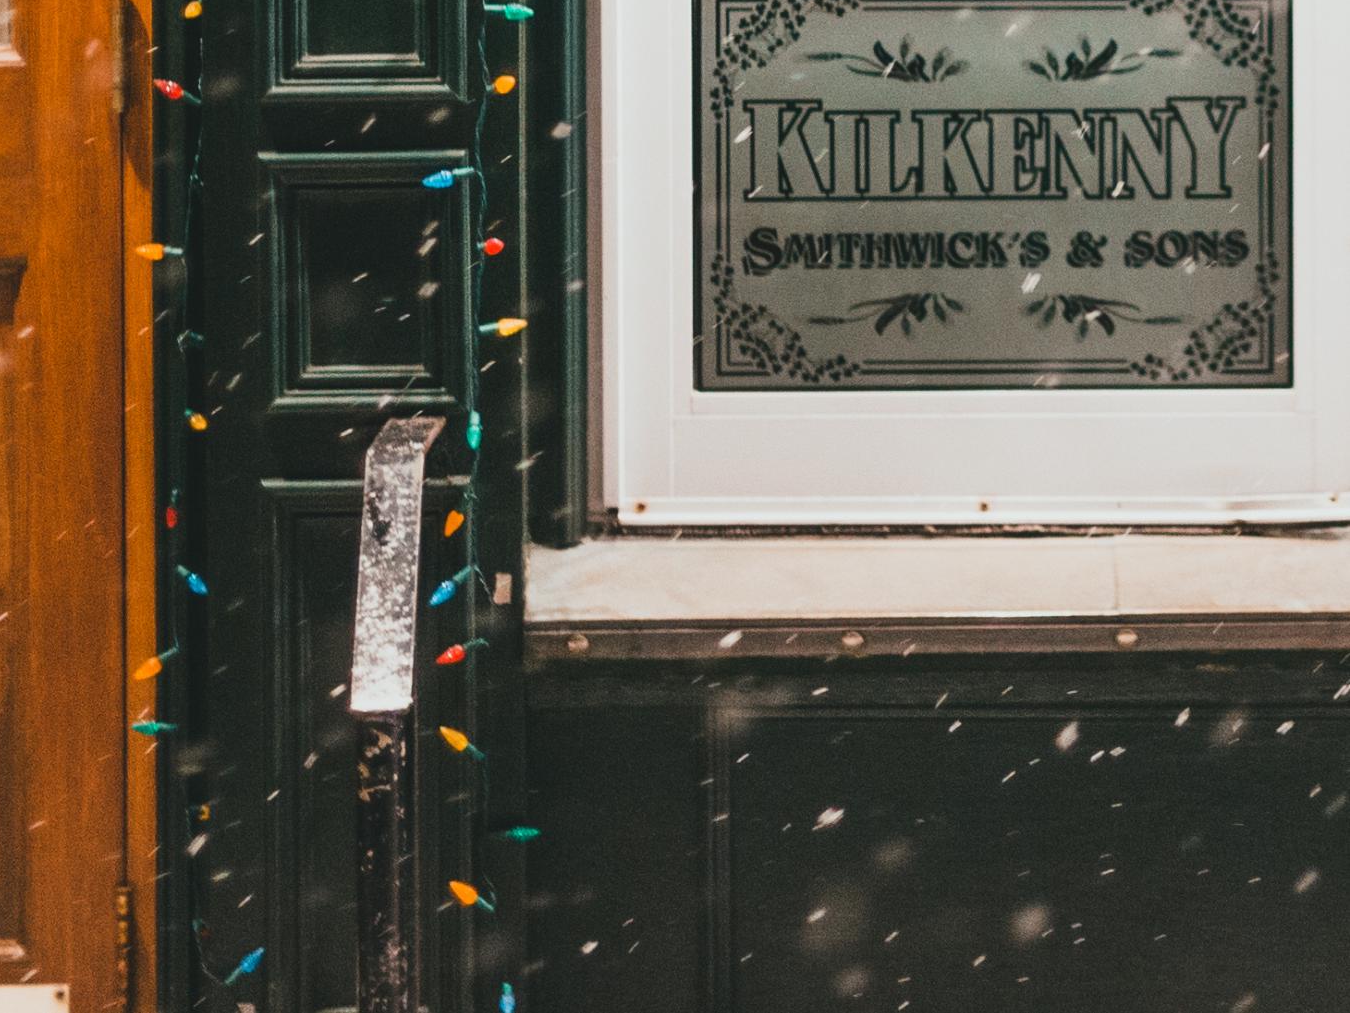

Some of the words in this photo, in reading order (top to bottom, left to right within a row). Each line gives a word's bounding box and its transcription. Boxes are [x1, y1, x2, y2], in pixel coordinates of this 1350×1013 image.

[742, 96, 1246, 202] KILKENNY
[743, 226, 1050, 275] SMITHWICK'S
[1065, 232, 1106, 268] &
[1124, 229, 1250, 268] SONS
